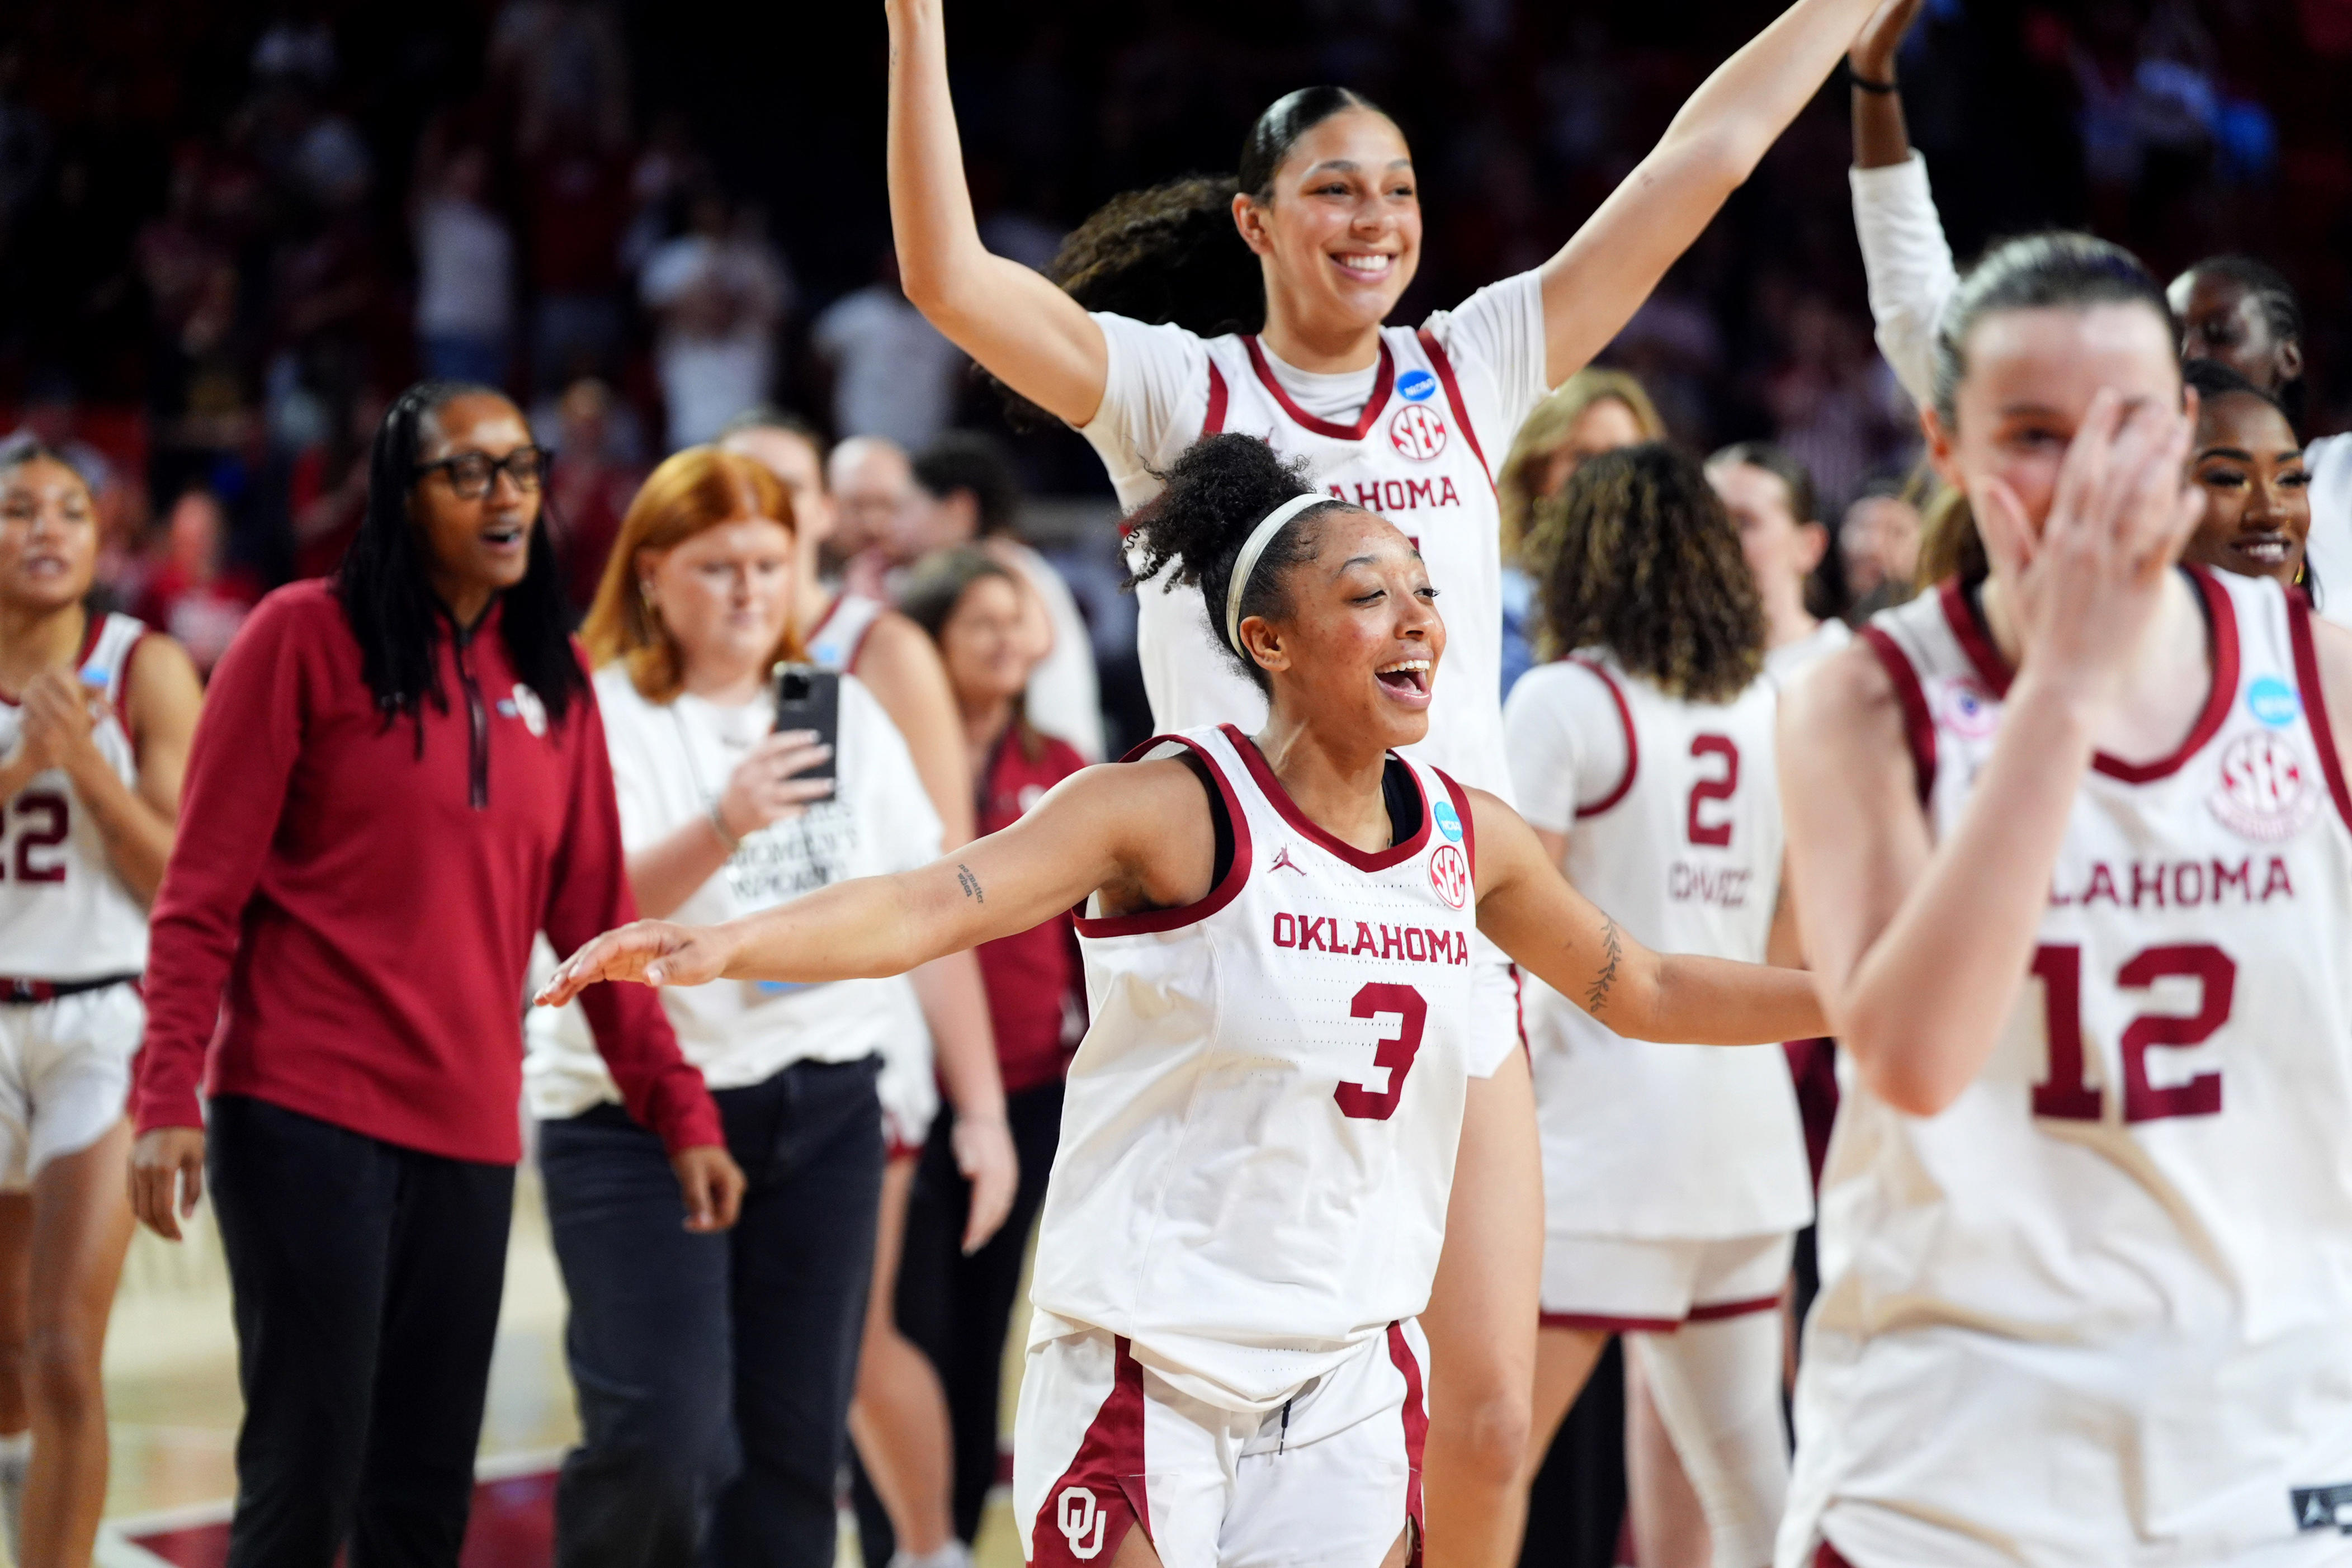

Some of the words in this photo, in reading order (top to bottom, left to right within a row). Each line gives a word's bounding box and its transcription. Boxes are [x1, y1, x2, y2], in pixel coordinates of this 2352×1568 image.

[1391, 405, 1447, 460] SEC
[1329, 476, 1460, 512] AHOMA
[1688, 733, 1739, 847] 2
[0, 791, 69, 882] 2
[957, 864, 970, 873] no
[967, 873, 984, 904] matter
[957, 873, 972, 898] when
[1431, 846, 1465, 907] SEC
[2051, 856, 2294, 908] AHOMA
[1273, 911, 1468, 967] OKLAHOMA
[1333, 982, 1428, 1121] 3
[2030, 943, 2236, 1124] 12
[1057, 1486, 1107, 1559] OU
